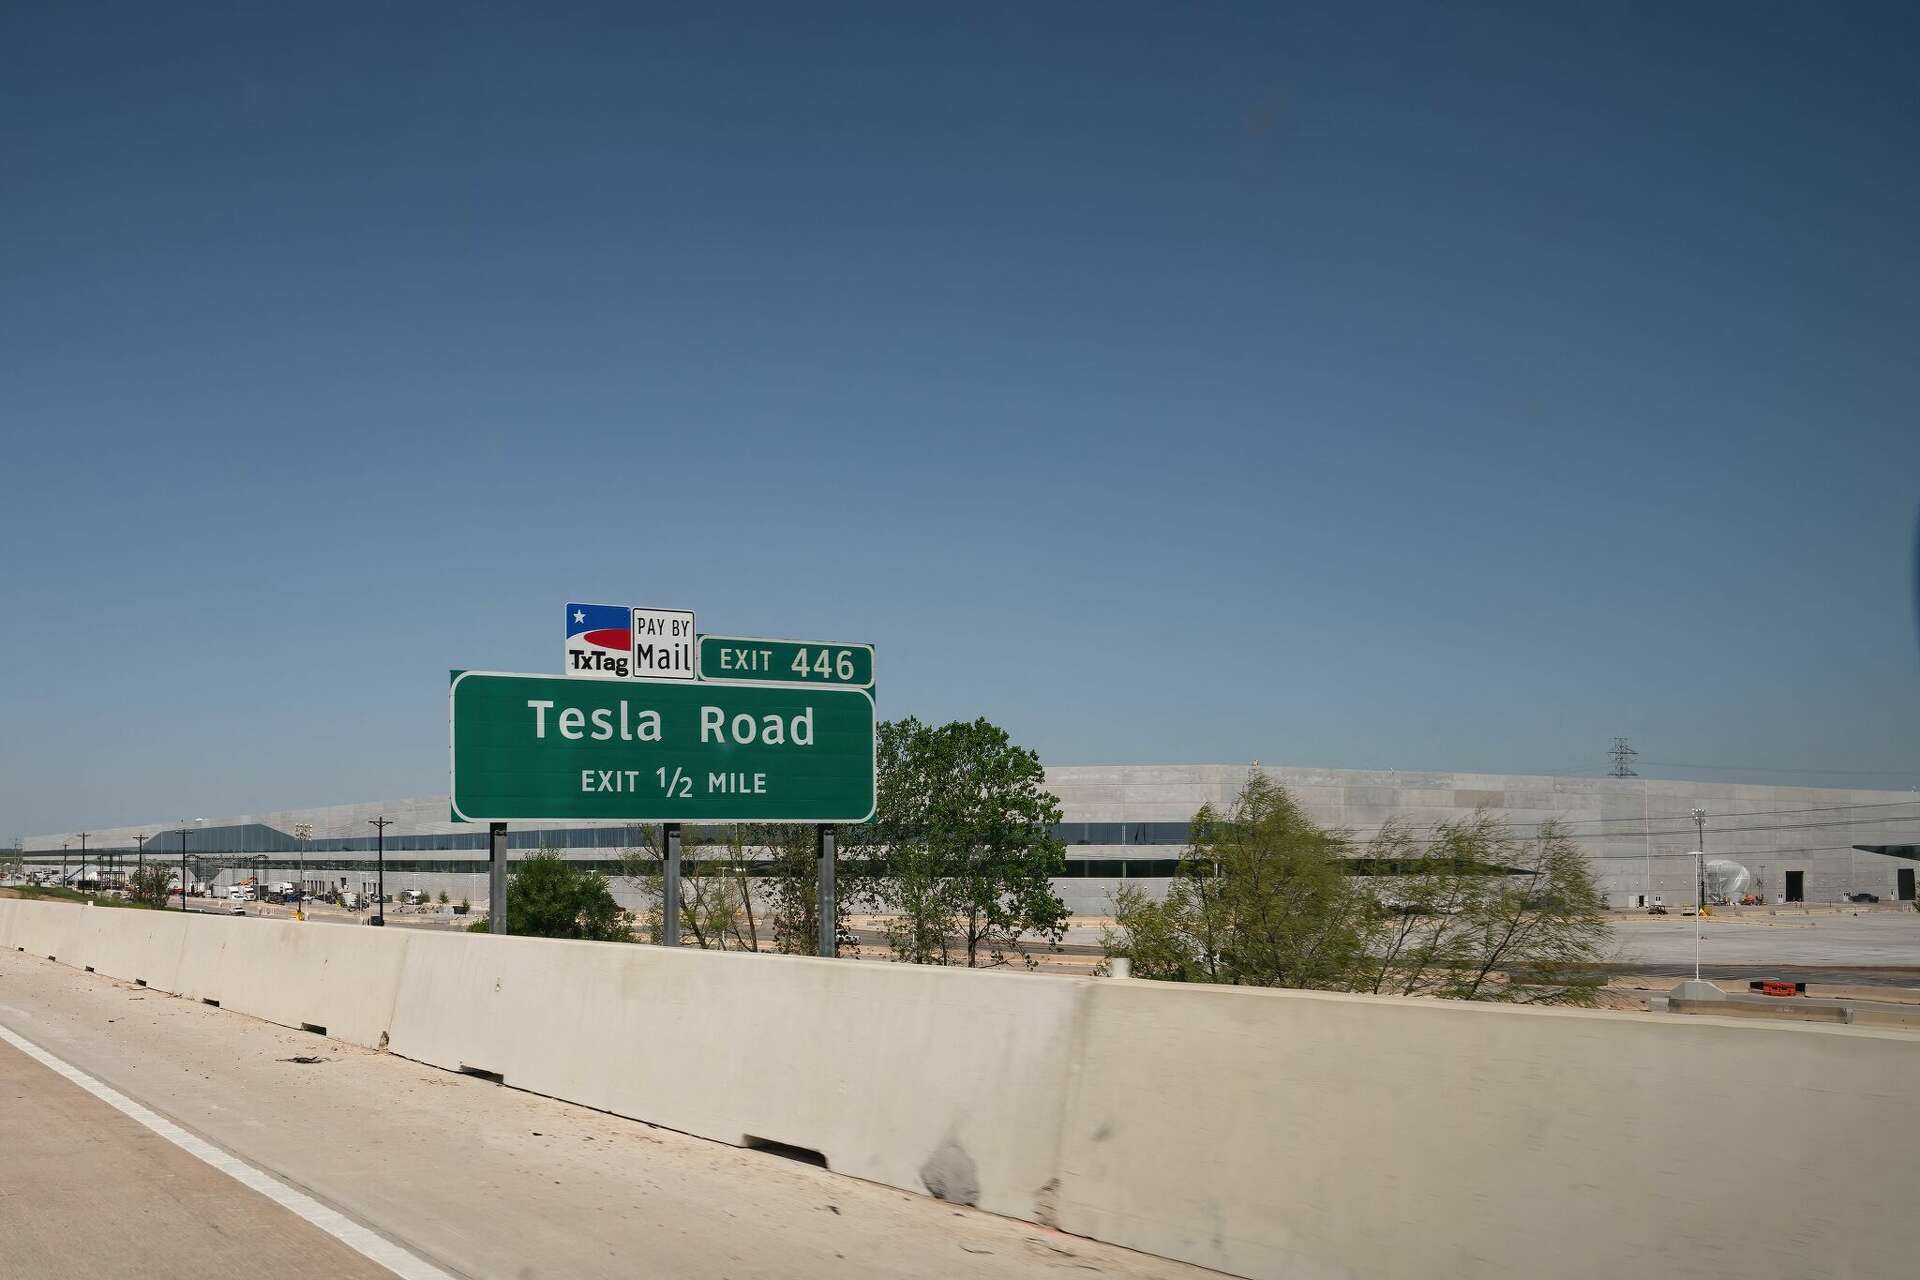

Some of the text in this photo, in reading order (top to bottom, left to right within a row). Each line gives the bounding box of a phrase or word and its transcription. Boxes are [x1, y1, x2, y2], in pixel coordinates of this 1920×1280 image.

[637, 618, 690, 637] PAY BY
[568, 649, 629, 677] TxTag
[636, 643, 690, 671] Mail
[719, 647, 855, 680] EXIT 446
[527, 699, 815, 746] Tesla Road
[581, 766, 767, 798] EXIT 1/2 MILE
